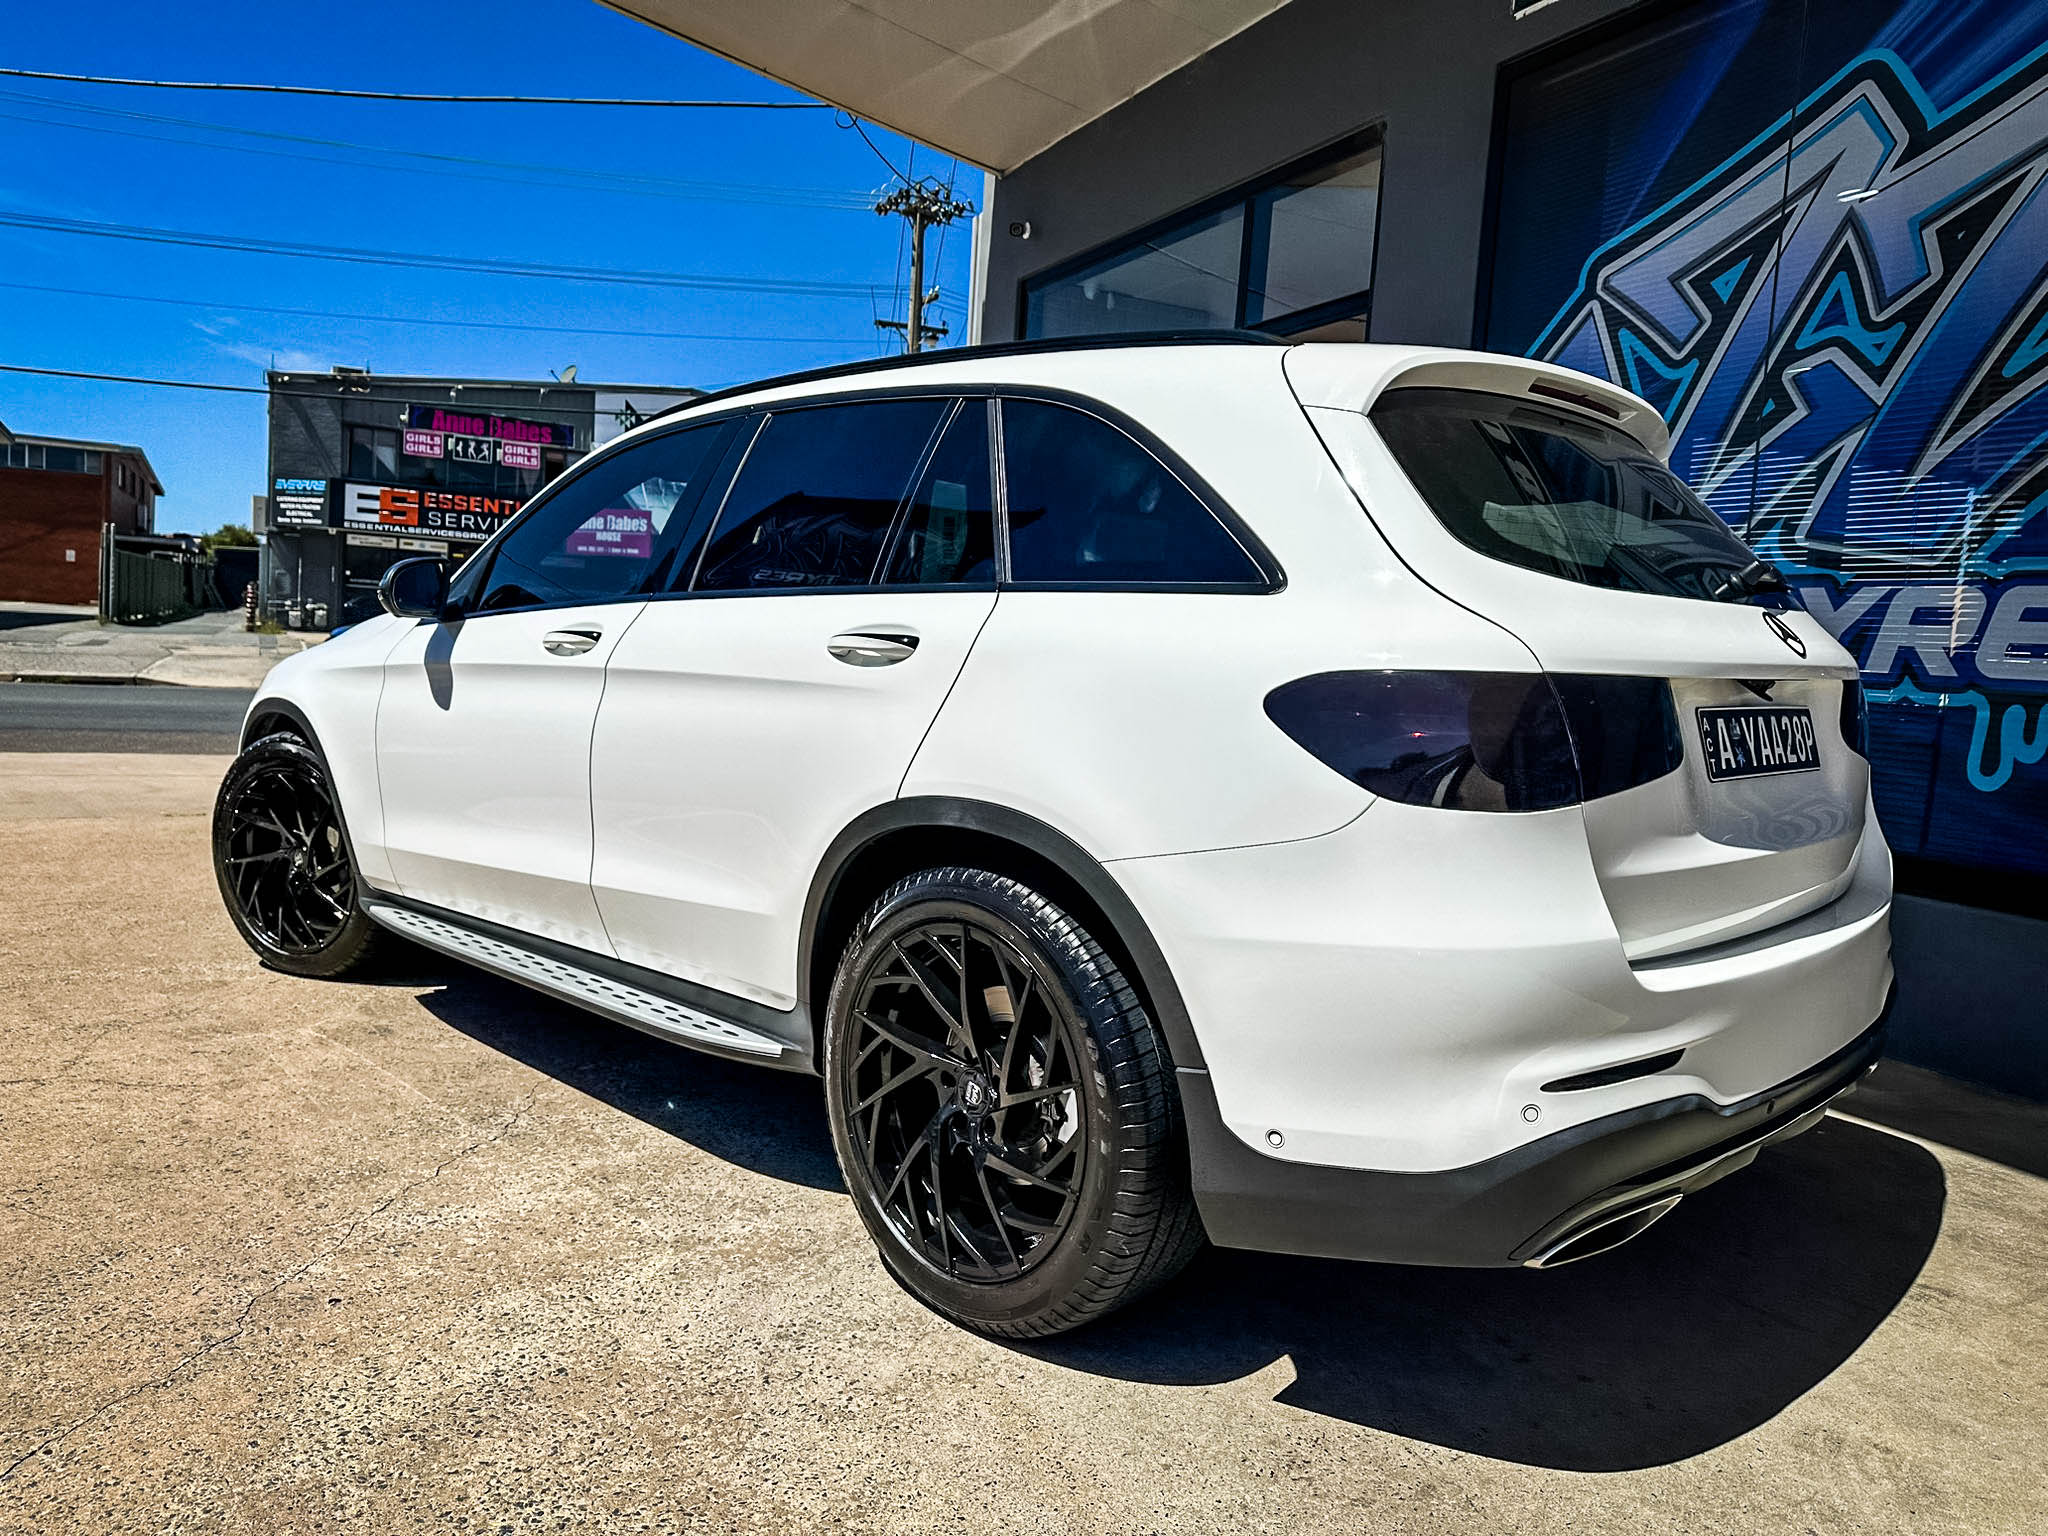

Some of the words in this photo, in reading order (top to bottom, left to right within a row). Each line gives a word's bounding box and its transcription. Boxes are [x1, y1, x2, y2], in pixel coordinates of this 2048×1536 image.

[432, 410, 485, 436] Anne
[489, 415, 552, 443] Babes
[406, 432, 441, 445] GIRLS
[406, 442, 441, 455] GIRLS
[504, 444, 538, 457] GIRLS
[504, 454, 538, 467] GIRLS
[1740, 715, 1814, 767] YAA28P
